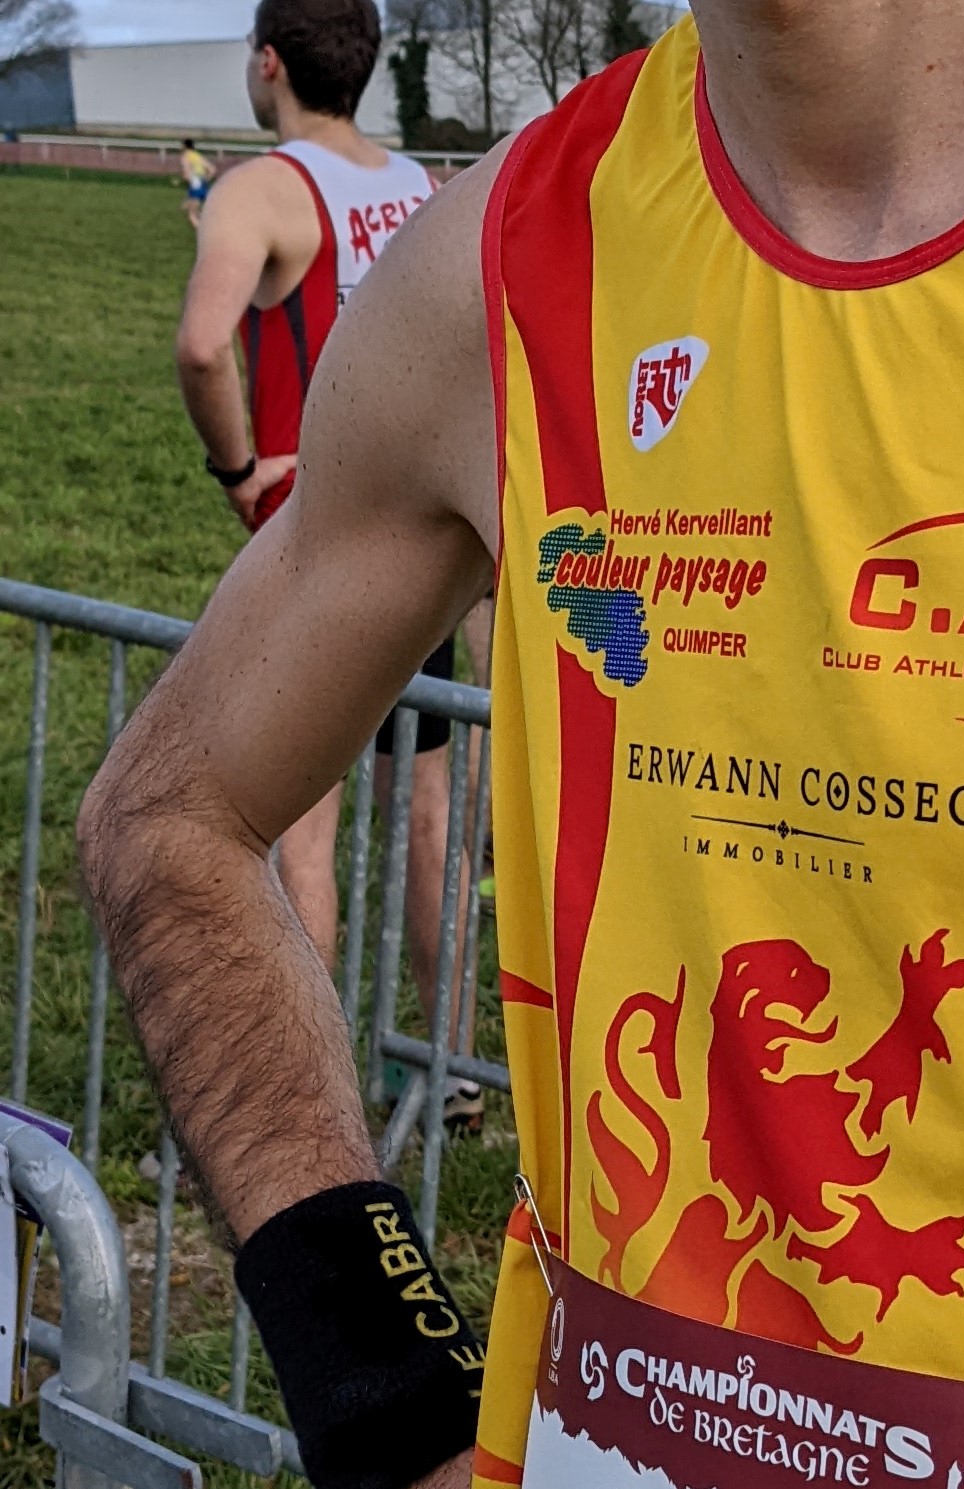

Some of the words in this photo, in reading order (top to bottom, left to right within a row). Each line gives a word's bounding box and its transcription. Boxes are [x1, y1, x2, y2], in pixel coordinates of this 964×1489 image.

[610, 508, 661, 536] Hervé
[665, 508, 773, 538] Kerveillant
[556, 538, 651, 591] couleur
[651, 552, 767, 610] paysage
[663, 627, 747, 658] QUIMPER
[627, 743, 781, 801] ERWANN
[683, 836, 873, 884] IMMOBILIER
[364, 1202, 461, 1339] CABRI
